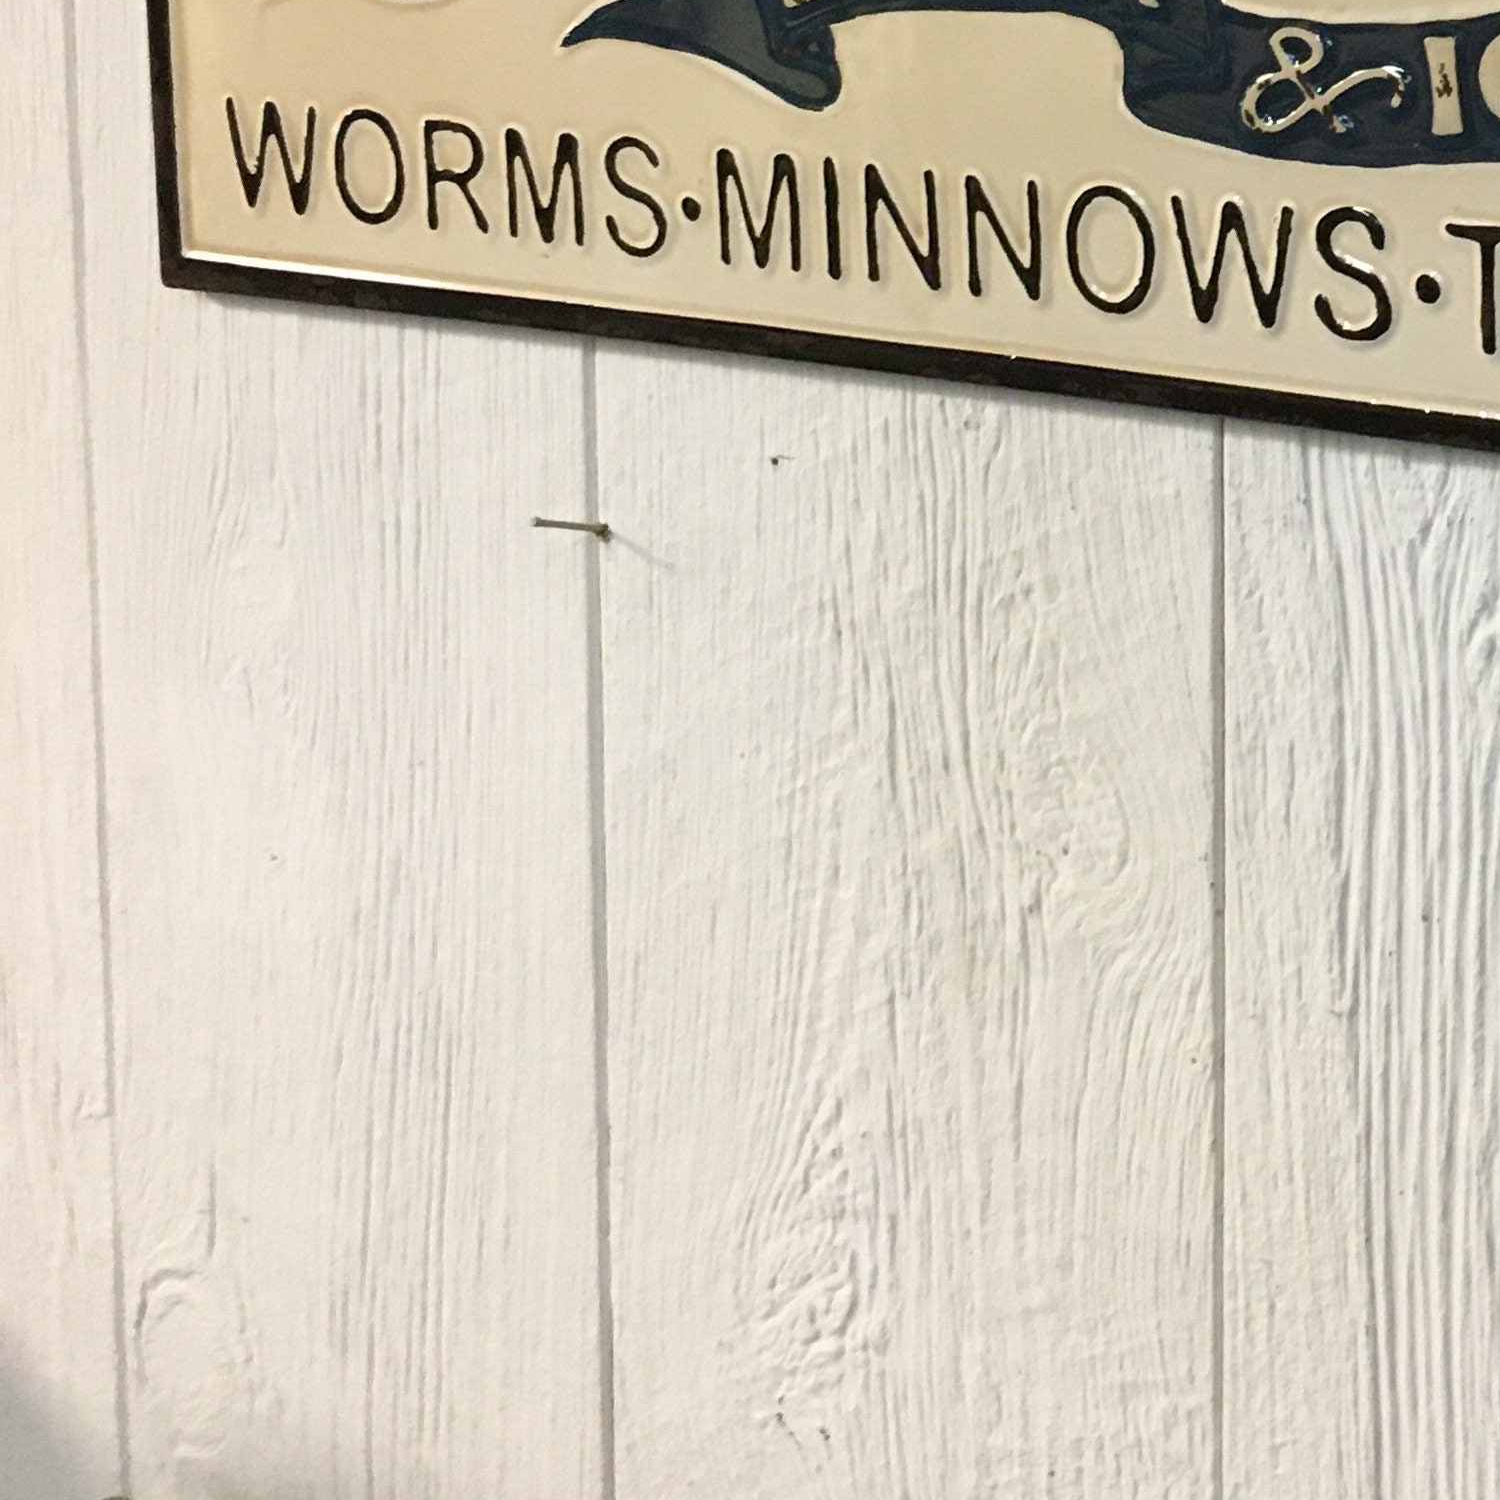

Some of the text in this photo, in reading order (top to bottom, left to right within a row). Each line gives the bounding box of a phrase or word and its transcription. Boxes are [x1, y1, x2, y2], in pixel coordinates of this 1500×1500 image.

[1239, 25, 1405, 136] &
[225, 96, 667, 259] WORMS
[715, 145, 1395, 343] MINNOWS
